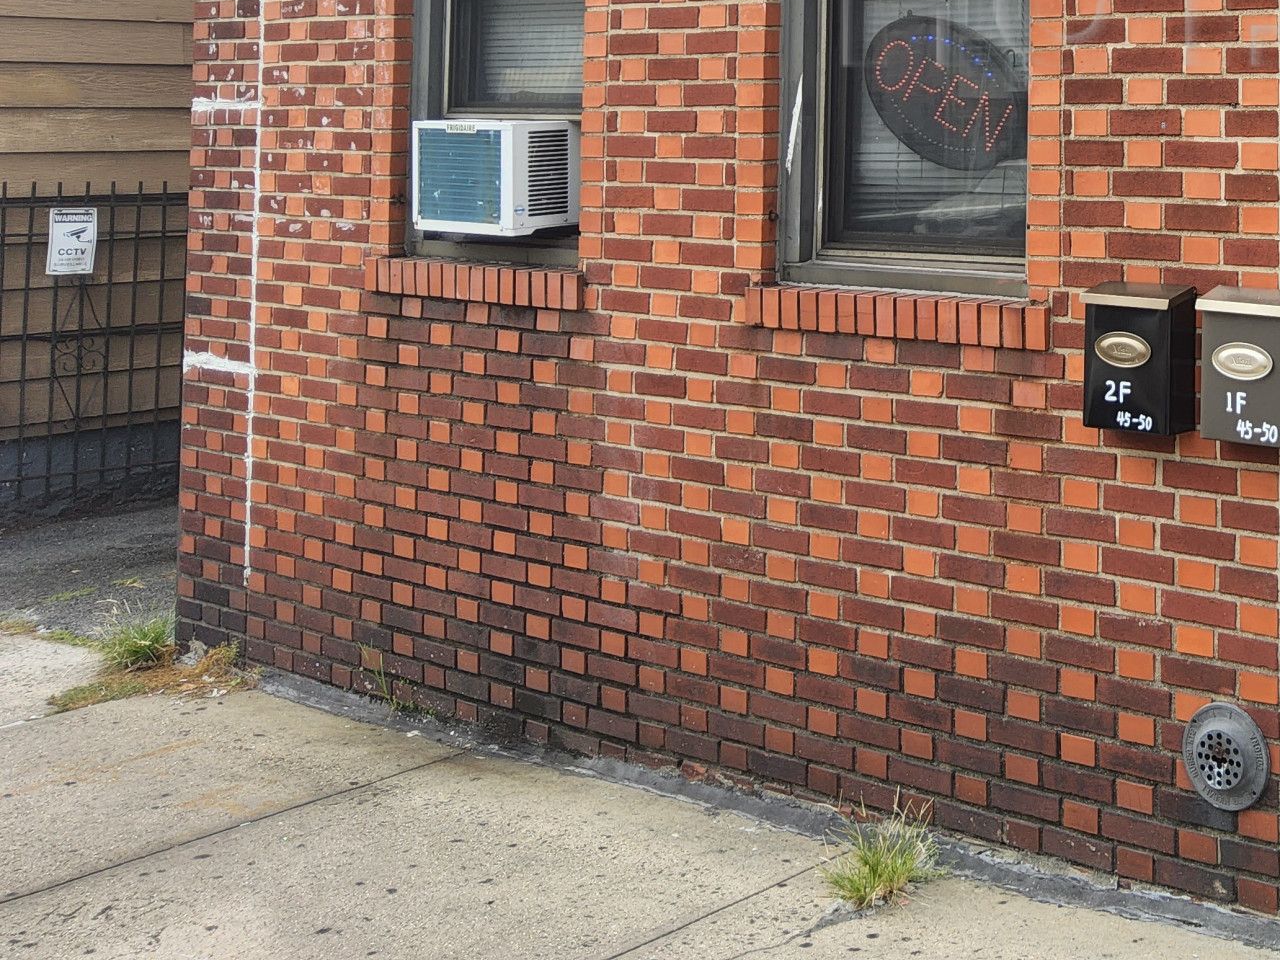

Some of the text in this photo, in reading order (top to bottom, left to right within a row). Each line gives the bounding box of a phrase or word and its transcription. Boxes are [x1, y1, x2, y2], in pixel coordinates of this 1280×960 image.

[875, 39, 1014, 152] OPEN
[446, 123, 476, 132] FRIGIDAIRE
[54, 213, 93, 222] WARNING
[58, 247, 87, 256] CCTV
[1104, 380, 1132, 404] 2F
[1225, 391, 1247, 415] 1F
[1116, 410, 1153, 432] 45-50
[1235, 418, 1279, 444] 45-50
